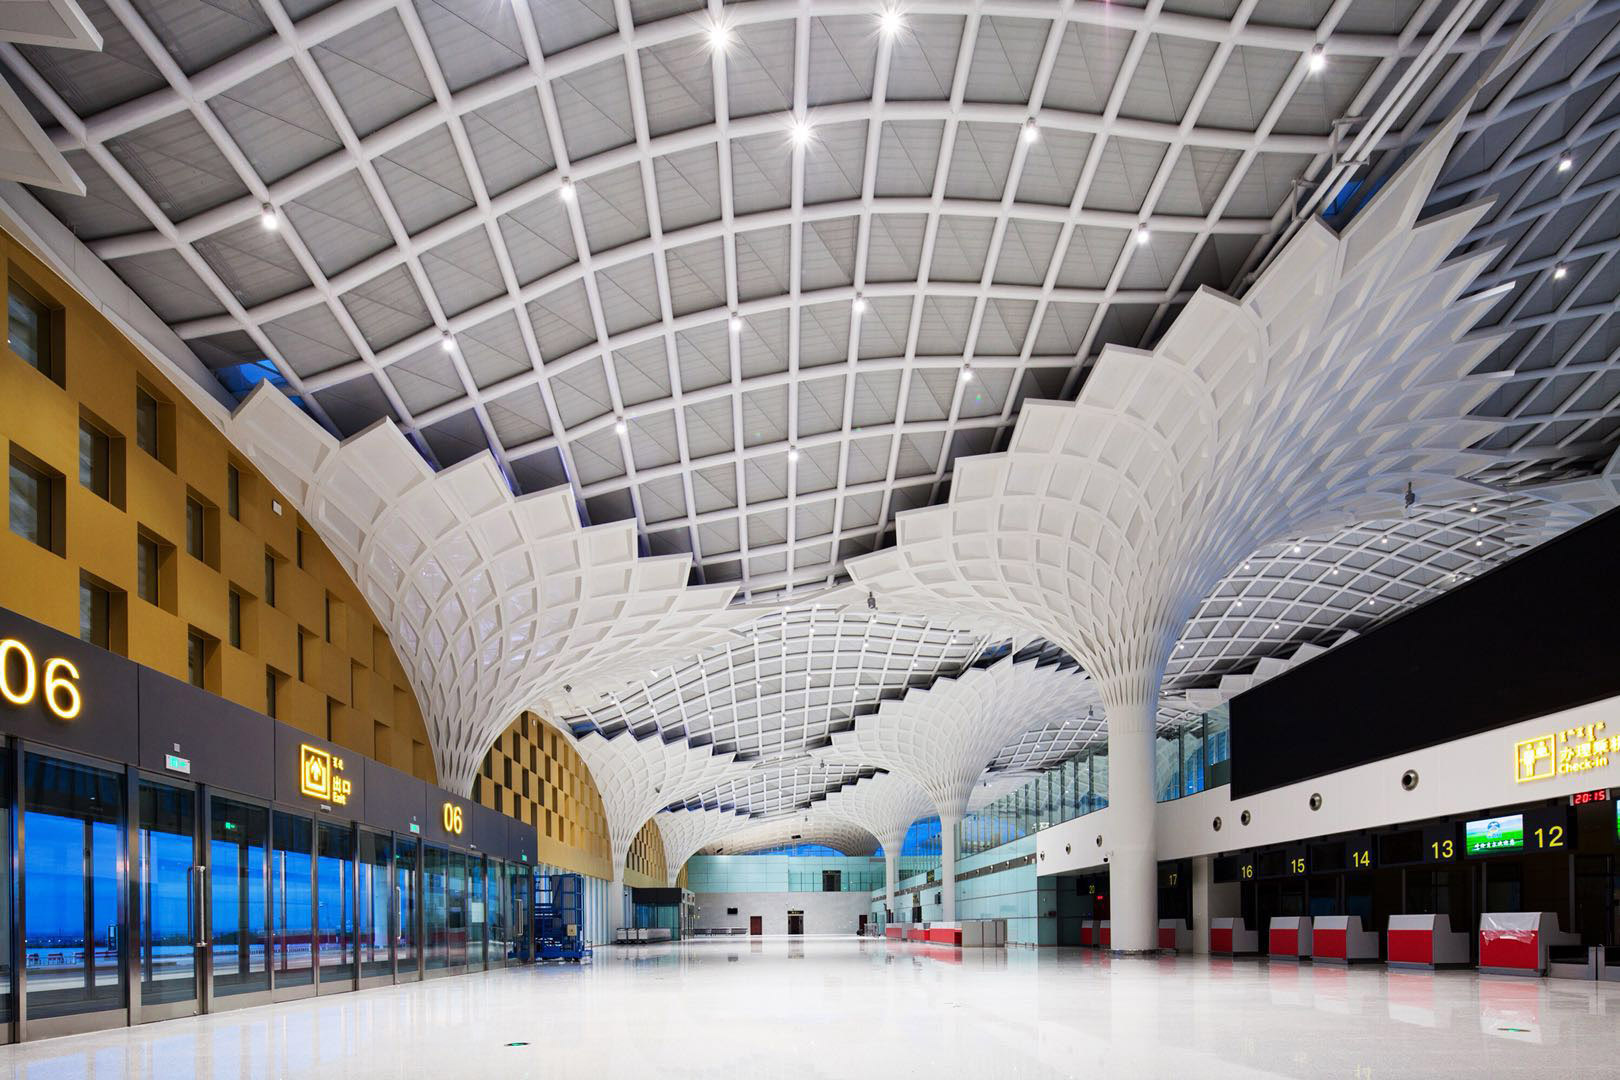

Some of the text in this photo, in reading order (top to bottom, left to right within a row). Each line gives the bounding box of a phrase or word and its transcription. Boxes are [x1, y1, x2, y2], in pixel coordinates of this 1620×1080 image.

[0, 639, 81, 719] 06
[1558, 751, 1609, 774] Check-in
[332, 775, 351, 795] 出口
[1575, 790, 1606, 805] 20:15
[443, 802, 463, 834] 06
[1534, 825, 1564, 849] 12
[1352, 850, 1370, 867] 14
[1431, 839, 1454, 860] 13
[1241, 865, 1253, 879] 16
[1291, 858, 1305, 873] 15
[1169, 873, 1178, 887] 17
